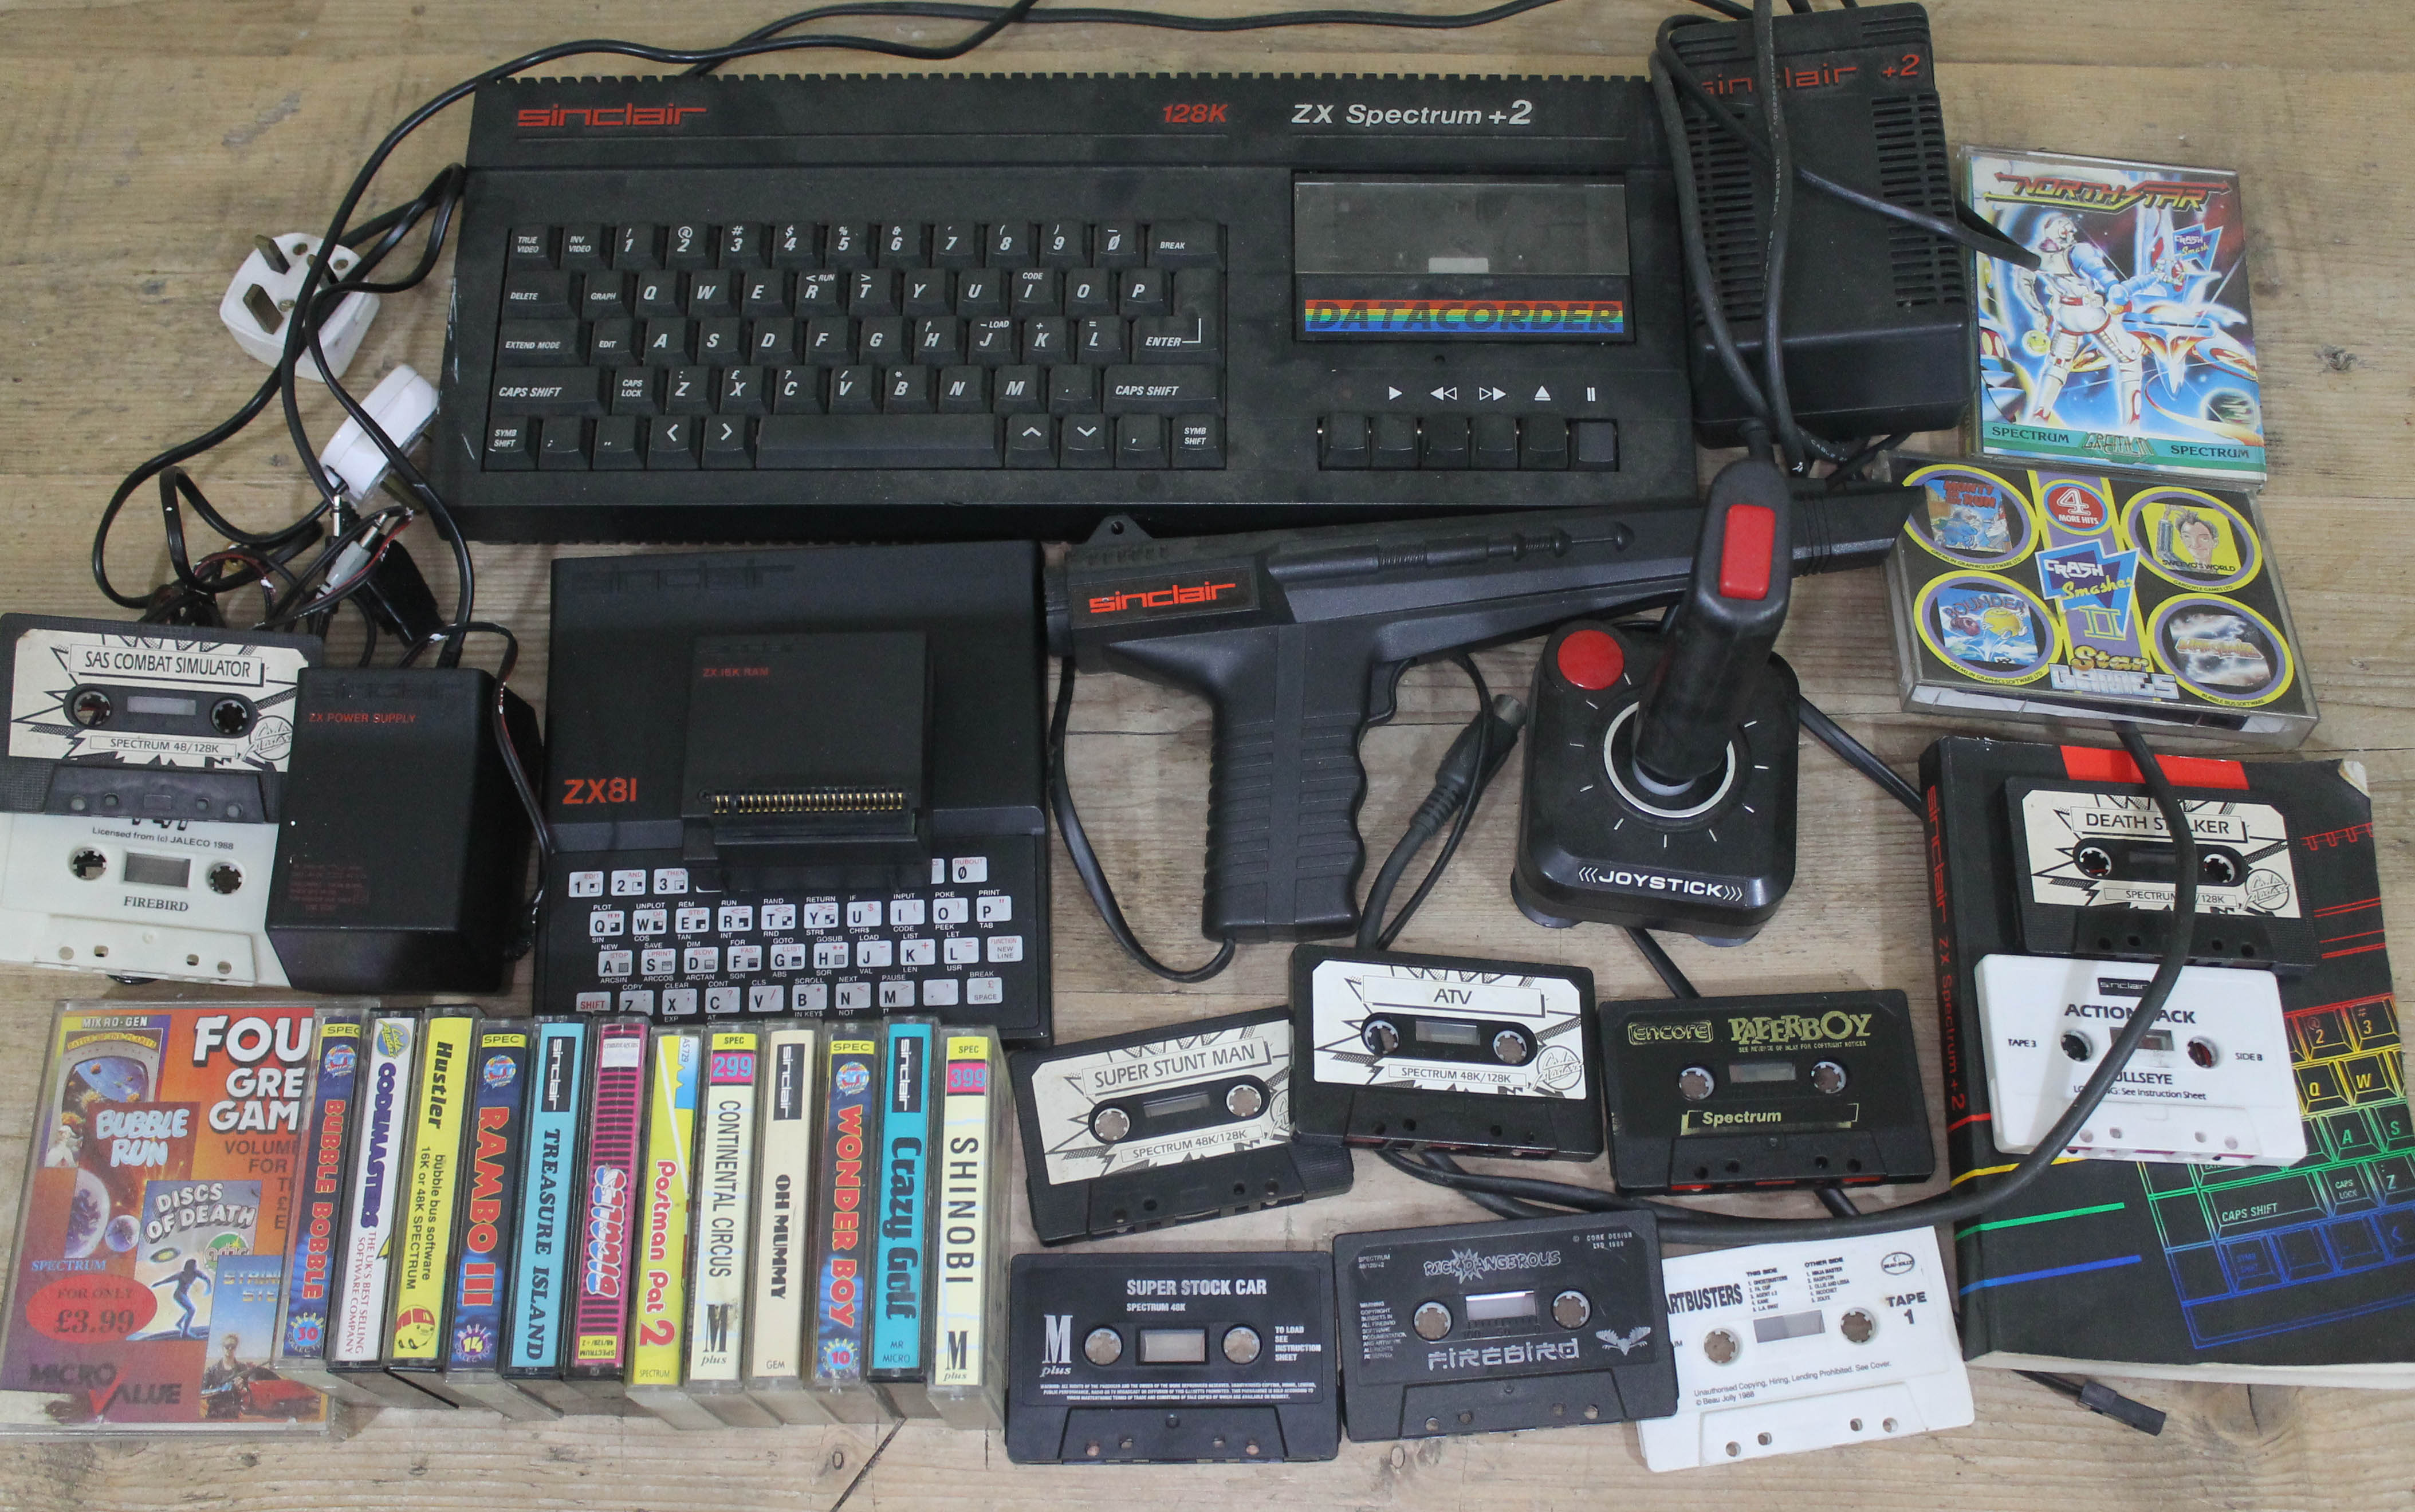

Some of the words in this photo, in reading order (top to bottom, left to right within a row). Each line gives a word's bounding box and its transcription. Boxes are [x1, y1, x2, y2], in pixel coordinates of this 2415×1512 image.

[1701, 63, 1858, 96] sinlair
[1882, 54, 1920, 77] +2
[517, 103, 706, 126] sinclair
[1163, 104, 1228, 123] 128K
[1292, 104, 1334, 124] ZX
[1346, 104, 1481, 127] Spectrum
[1489, 100, 1533, 125] +2
[1161, 241, 1185, 249] BREAK
[2182, 244, 2209, 256] Smash
[1309, 302, 1623, 331] DATACORDER
[1146, 337, 1181, 346] ENTER
[499, 387, 527, 397] CAPS
[530, 387, 561, 396] SHIFT
[1992, 427, 2070, 444] SPECTRUM
[2171, 445, 2249, 458] SPECTRUM
[2056, 488, 2089, 516] 4
[2058, 514, 2079, 524] MORE
[2082, 517, 2098, 525] HITS
[2042, 560, 2104, 578] CRASH
[2203, 563, 2236, 572] WORLD
[1089, 581, 1236, 613] sinclair
[2062, 576, 2134, 600] Smashes
[1945, 593, 2027, 617] BOUNDER
[85, 651, 110, 668] SAS
[115, 653, 173, 671] COMBAT
[176, 657, 250, 678] SIMULATOR
[2072, 645, 2149, 671] Star
[309, 713, 323, 722] ZX
[328, 713, 368, 723] POWER
[373, 714, 416, 723] SUPPLY
[111, 739, 170, 750] SPECTRUM
[174, 742, 219, 754] 48/128K
[563, 777, 637, 804] ZX81
[2086, 813, 2147, 829] DEATH
[93, 827, 131, 839] Licensed
[133, 832, 154, 841] from
[157, 833, 168, 843] (c)
[171, 837, 210, 848] JALECO
[214, 841, 234, 850] 1988
[1927, 785, 1946, 922] sinclair
[1598, 870, 1722, 897] JOYSTICK
[124, 896, 188, 912] FIREBIRD
[1939, 938, 1950, 964] ZX
[1434, 989, 1472, 1005] ATV
[1728, 1011, 1872, 1044] PAPERBOY
[1944, 974, 1958, 1074] Spectrum
[2156, 1010, 2196, 1023] ACK
[193, 1015, 313, 1064] FOU
[484, 1035, 520, 1044] SPEC
[2008, 1039, 2030, 1047] TAPE
[713, 1056, 752, 1078] 299
[1094, 1064, 1149, 1088] SUPER
[1154, 1052, 1206, 1078] STUNT
[1213, 1044, 1255, 1066] MAN
[2235, 1052, 2255, 1061] SIDE
[428, 1041, 454, 1129] Hustler
[899, 1038, 910, 1111] sinclair
[1402, 1068, 1457, 1080] SPECTRUM
[1461, 1071, 1511, 1083] 48K/128K
[2138, 1089, 2181, 1098] Instruction
[2183, 1091, 2206, 1100] Sheet
[96, 1109, 190, 1140] BUBBLE
[1702, 1111, 1781, 1127] Spectrum
[110, 1140, 168, 1167] RUN
[314, 1100, 346, 1194] BUBBLE
[361, 1062, 397, 1228] CODEMASTERS
[711, 1100, 741, 1212] CONTINENTAL
[1133, 1140, 1193, 1159] SPECTRUM
[1195, 1130, 1247, 1147] 48K/128K
[249, 1159, 287, 1173] FOR
[419, 1147, 430, 1170] 16K
[417, 1173, 426, 1187] or
[432, 1154, 446, 1196] bubble
[467, 1107, 509, 1253] RAMBO
[832, 1104, 863, 1251] WONDER
[882, 1136, 922, 1241] Crazy
[155, 1182, 223, 1213] DISCS
[415, 1188, 427, 1211] 48K
[535, 1128, 560, 1256] TREASURE
[774, 1175, 791, 1210] OH
[145, 1216, 174, 1242] OF
[180, 1204, 257, 1227] DEATH
[428, 1200, 440, 1223] bus
[648, 1160, 678, 1261] Postman
[946, 1137, 979, 1283] SHINOBI
[2222, 1208, 2247, 1222] CAPS
[2251, 1203, 2278, 1217] SHIFT
[367, 1231, 376, 1251] THE
[586, 1164, 627, 1297] BIGGLES
[302, 1202, 333, 1300] BOBBLE
[406, 1215, 424, 1289] SPECTRUM
[422, 1227, 438, 1280] software
[709, 1218, 734, 1277] CIRCUS
[770, 1215, 789, 1300] MUMMY
[31, 1260, 107, 1271] SPECTRUM
[352, 1237, 365, 1294] SOFTWARE
[363, 1255, 375, 1279] UK'S
[57, 1287, 88, 1300] FOR
[92, 1287, 132, 1300] ONLY
[361, 1282, 372, 1307] BEST
[462, 1262, 496, 1306] III
[646, 1269, 670, 1314] Pat
[829, 1258, 857, 1328] BOY
[886, 1247, 918, 1320] Golf
[1127, 1279, 1177, 1296] SUPER
[1181, 1279, 1231, 1296] STOCK
[1236, 1279, 1267, 1295] CAR
[526, 1266, 549, 1360] ISLAND
[1126, 1303, 1169, 1312] SPECTRUM
[1171, 1302, 1186, 1311] 48K
[1665, 1283, 1743, 1316] ARTBUSTERS
[1886, 1292, 1927, 1308] TAPE
[54, 1309, 135, 1334] £3.99
[344, 1297, 360, 1353] COMPANY
[1904, 1309, 1915, 1325] 1
[355, 1309, 369, 1353] SELLING
[639, 1319, 675, 1347] 2
[1041, 1314, 1073, 1364] M
[882, 1354, 910, 1363] MICRO
[890, 1341, 903, 1349] MR
[1040, 1365, 1071, 1378] plus
[1694, 1383, 1737, 1397] Unauthorised
[1739, 1380, 1768, 1390] Copying,
[1769, 1376, 1790, 1385] Hiring,
[1792, 1372, 1818, 1383] Lending
[1819, 1367, 1854, 1377] Prohibited.
[1870, 1360, 1891, 1369] Cover.
